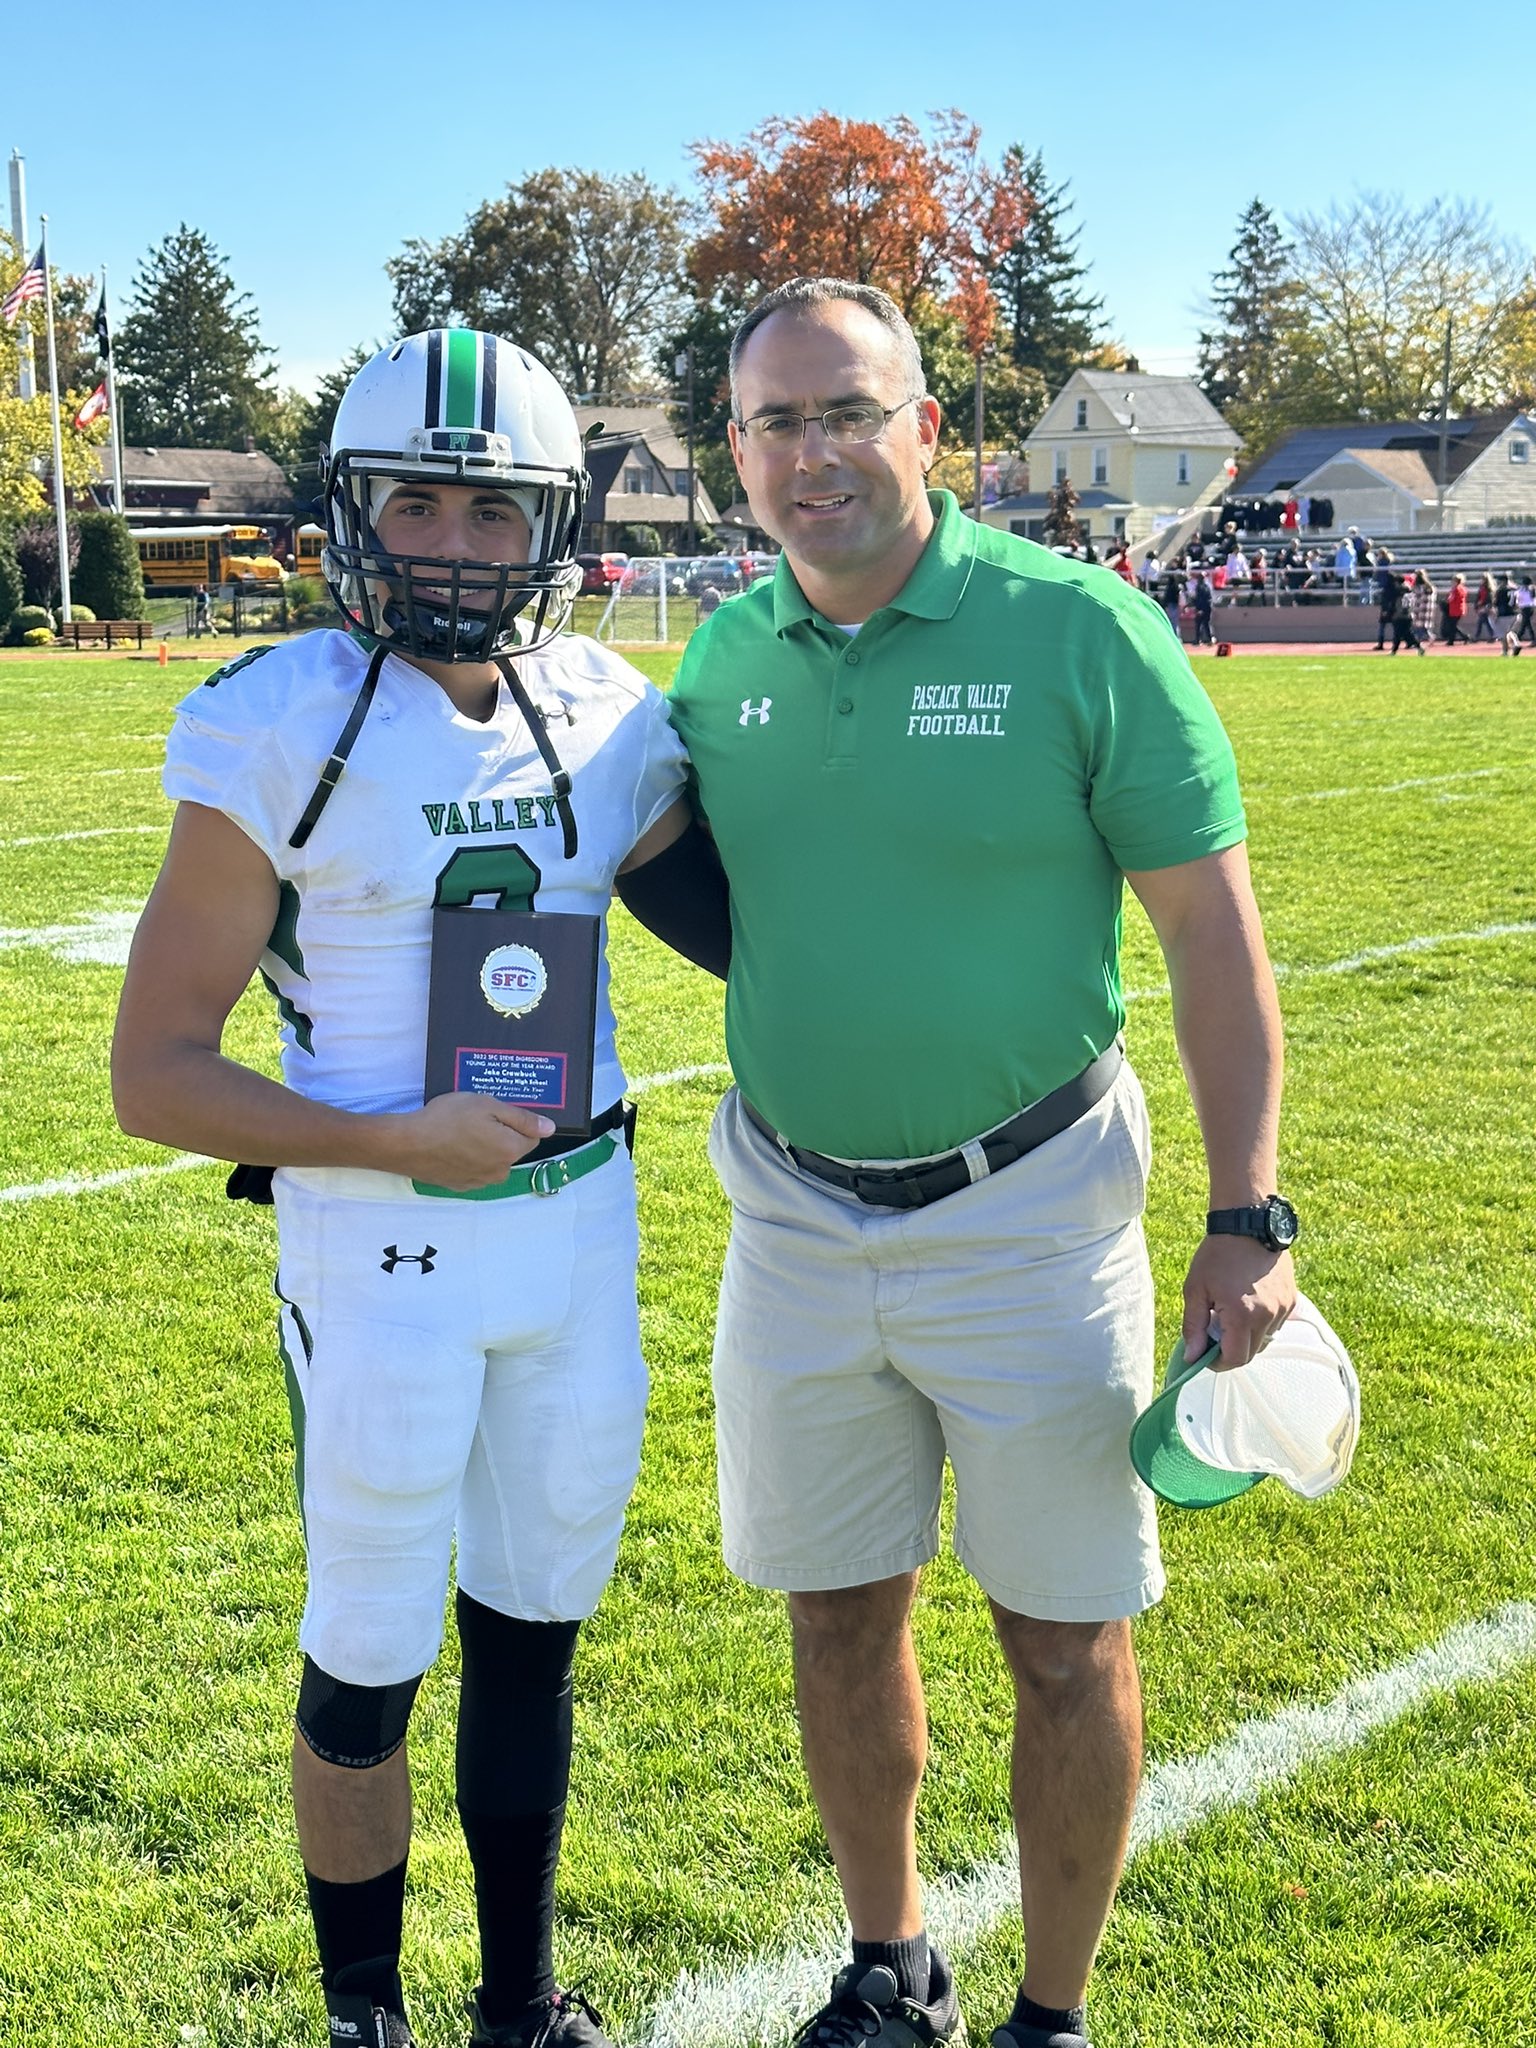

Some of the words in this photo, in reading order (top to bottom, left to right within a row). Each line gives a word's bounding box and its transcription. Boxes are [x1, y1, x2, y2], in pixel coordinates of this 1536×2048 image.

[448, 434, 470, 449] PV
[433, 616, 471, 631] Ridell
[911, 684, 962, 710] PASCACK
[967, 684, 1012, 709] VALLEY
[906, 714, 1005, 736] FOOTBALL
[421, 795, 558, 836] VALLEY
[491, 972, 529, 988] SFC
[483, 1068, 500, 1076] Jake
[529, 1078, 548, 1086] School
